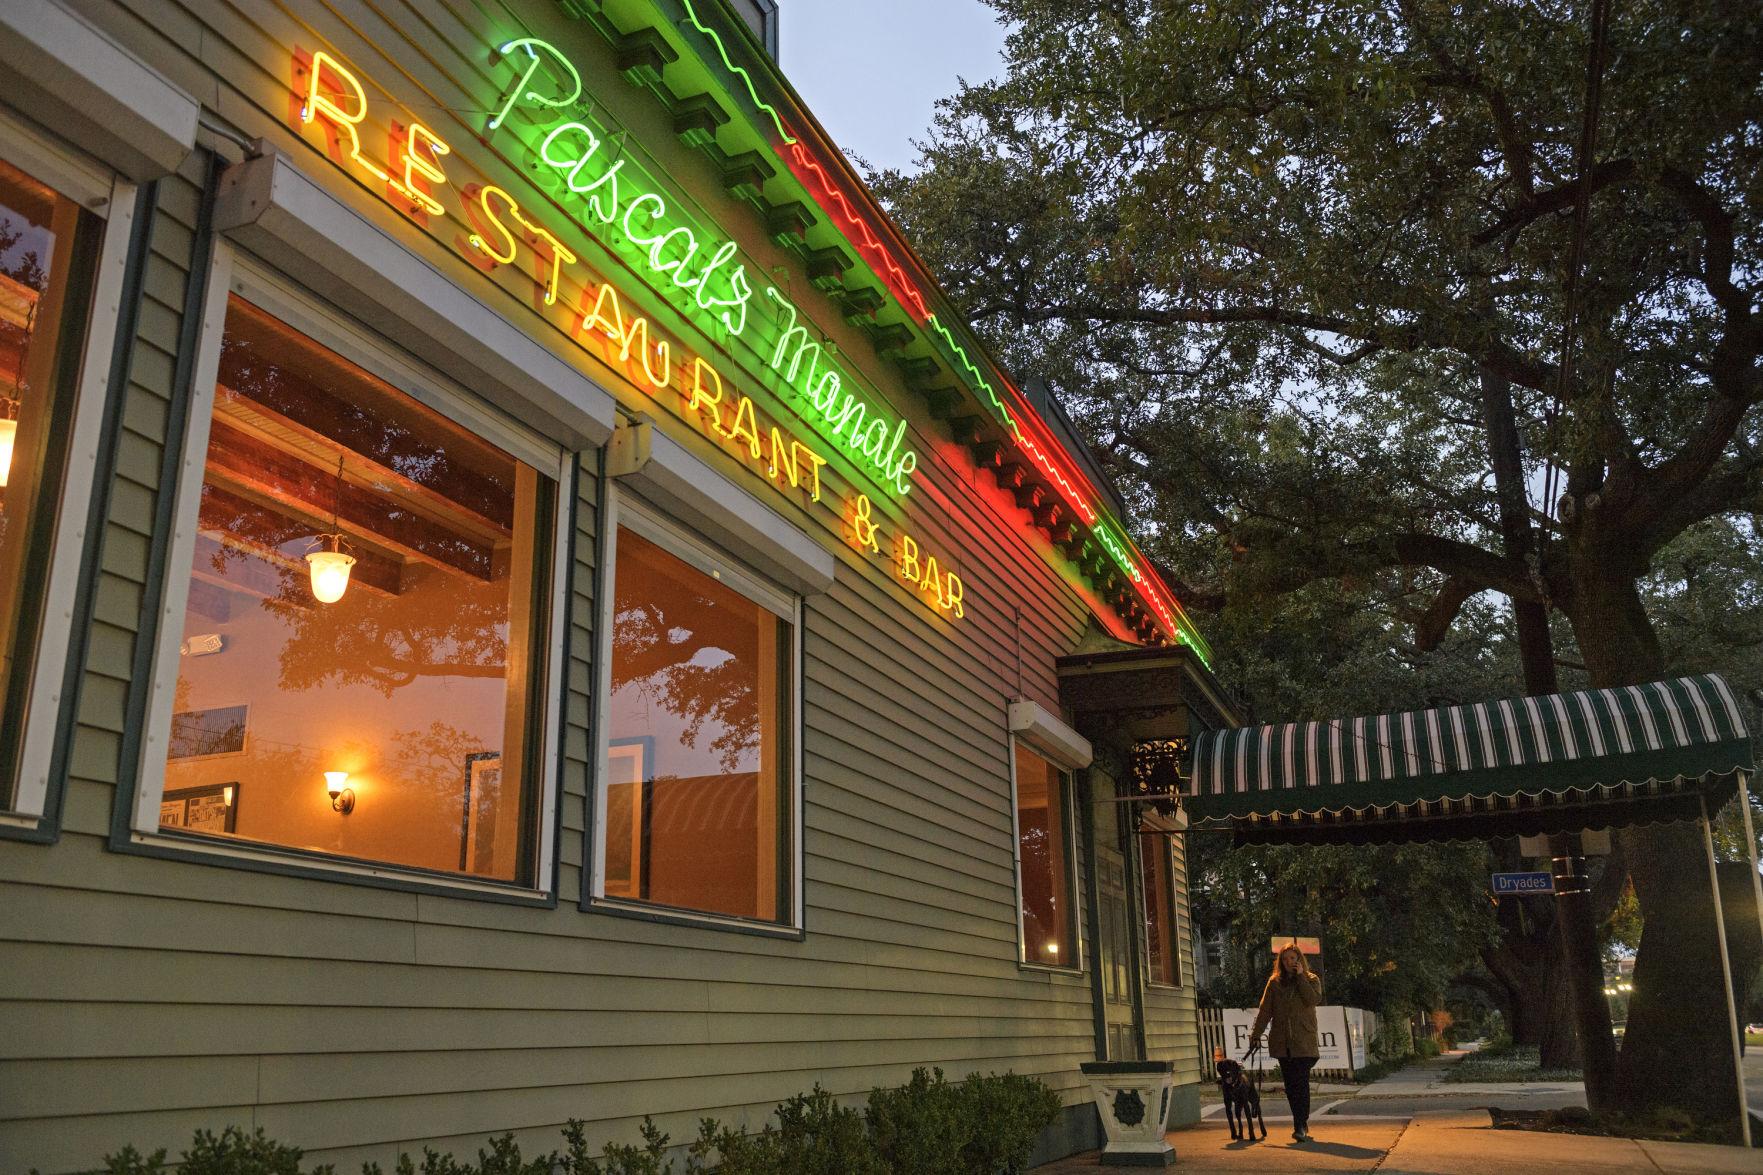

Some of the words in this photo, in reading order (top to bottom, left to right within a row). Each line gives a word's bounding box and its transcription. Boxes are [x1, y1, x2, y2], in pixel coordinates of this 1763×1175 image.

[301, 50, 828, 503] RESTAURANT
[854, 494, 881, 554] &
[901, 535, 964, 619] BAR
[1500, 877, 1546, 890] Dryades
